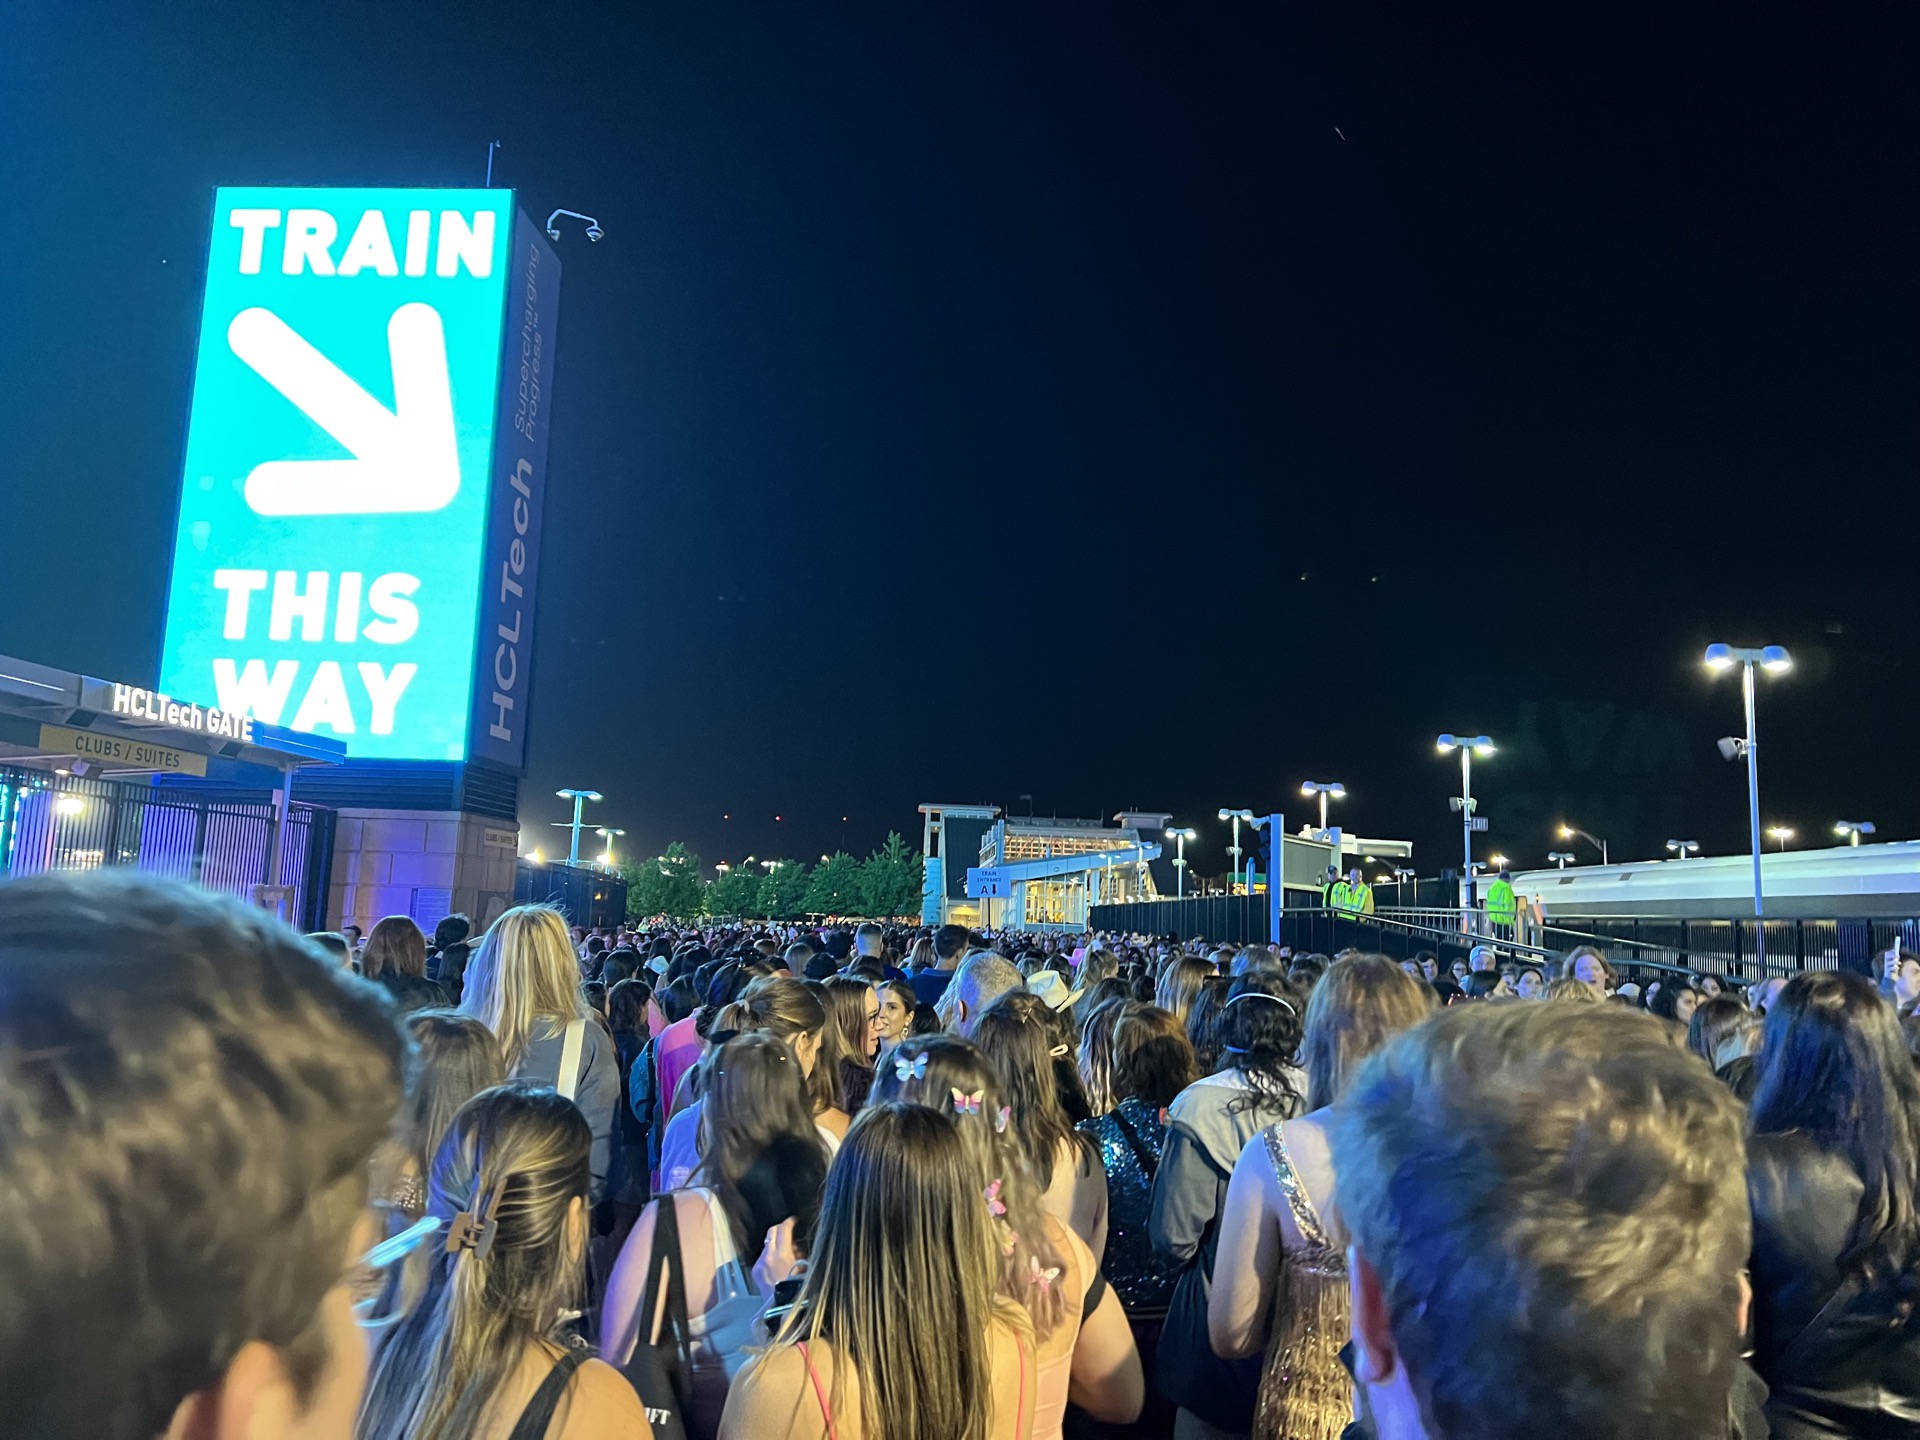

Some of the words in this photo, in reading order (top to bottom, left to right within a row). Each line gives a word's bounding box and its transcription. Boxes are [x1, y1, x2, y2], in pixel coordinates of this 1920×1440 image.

[229, 208, 495, 278] TRAIN
[515, 243, 540, 433] Supercharging
[213, 568, 421, 645] THIS
[113, 682, 202, 730] HCLTech
[206, 707, 254, 742] GATE
[212, 658, 418, 735] WAY
[75, 736, 121, 757] CLUBS
[124, 744, 132, 760] /
[135, 747, 180, 768] SUITES
[980, 885, 988, 895] A
